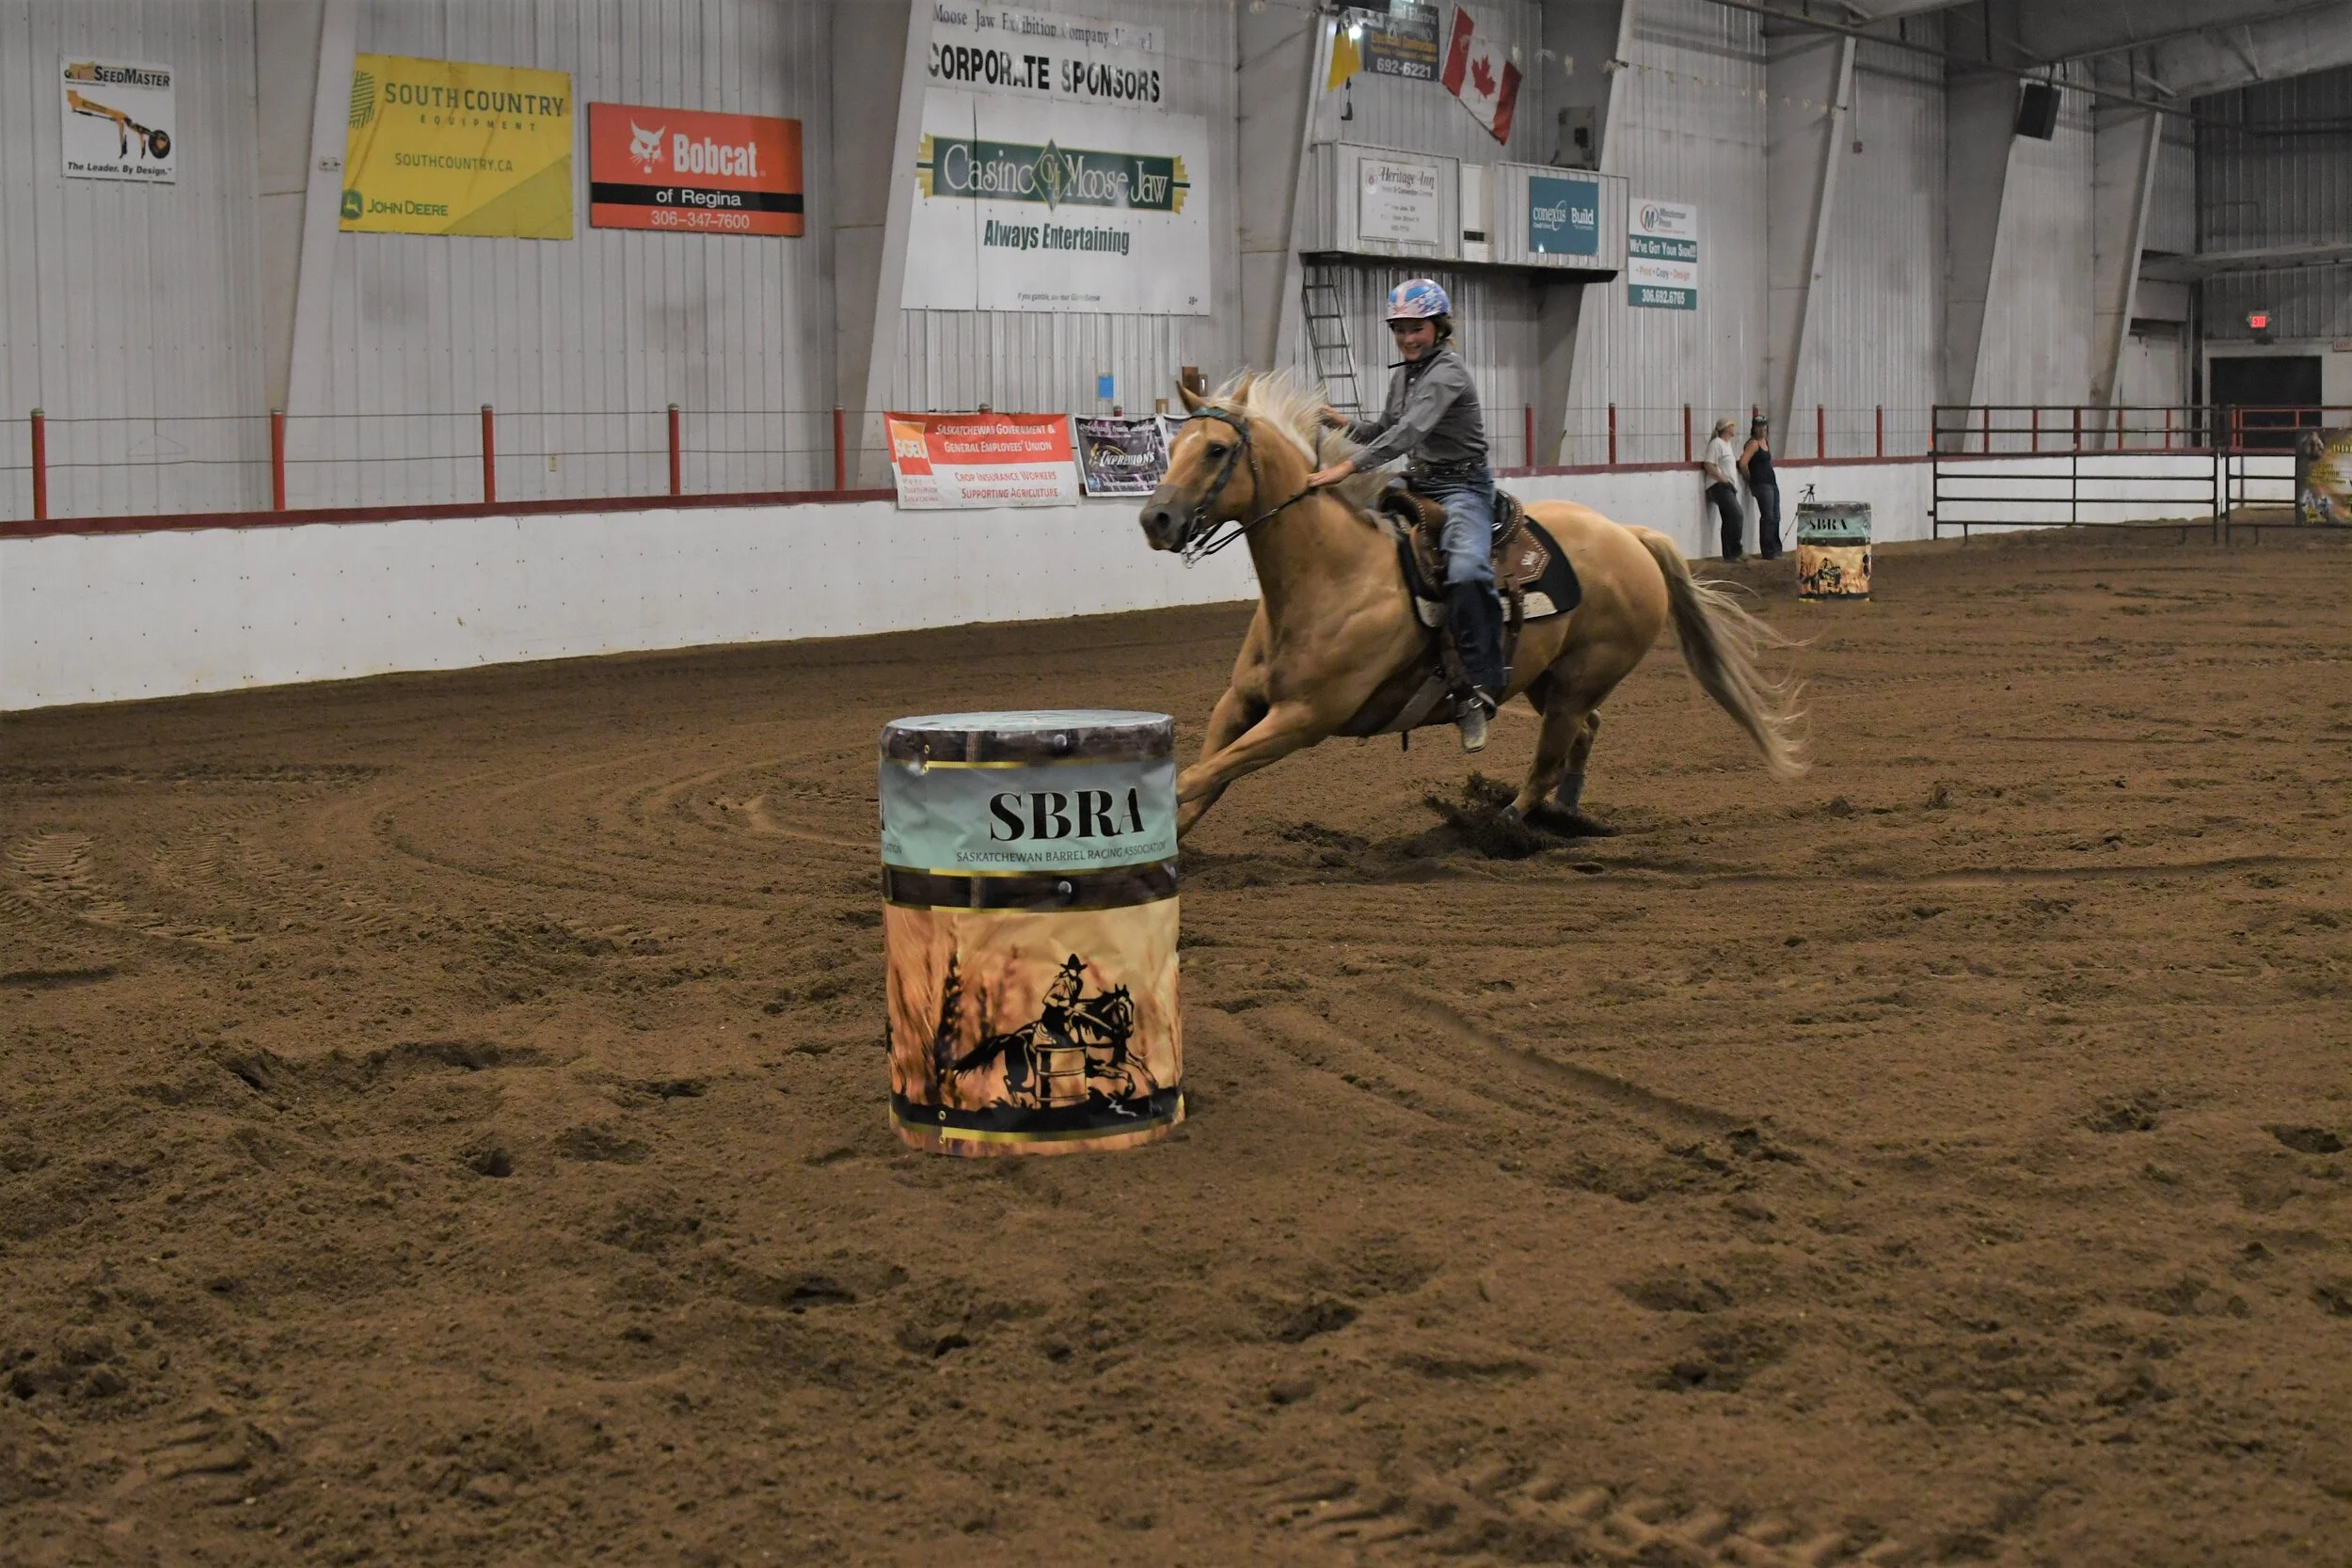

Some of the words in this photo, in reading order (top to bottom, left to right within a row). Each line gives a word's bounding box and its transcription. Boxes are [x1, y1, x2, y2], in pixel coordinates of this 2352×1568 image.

[975, 9, 994, 32] Jaw
[1002, 12, 1057, 37] Exibition
[1058, 24, 1109, 48] ompany
[1376, 57, 1431, 78] 692-6221
[1061, 58, 1160, 103] SPONSORS
[421, 114, 536, 132] EQUIPMENT
[395, 152, 513, 172] SOUTHCOUNTRY.CA
[673, 134, 757, 178] Bobcat
[68, 161, 84, 170] The
[87, 163, 119, 173] Leader.
[122, 165, 134, 174] By
[944, 144, 1034, 195] Casino
[1065, 153, 1129, 200] Moose
[1130, 160, 1168, 203] Jaw
[1378, 166, 1416, 188] Heritage
[1418, 171, 1435, 190] Inn
[367, 198, 403, 214] JOHN
[405, 200, 449, 216] DEERE
[657, 188, 674, 203] of
[682, 190, 741, 208] Regina
[651, 210, 750, 230] 306-347-7600
[1571, 207, 1594, 225] Build
[983, 220, 1039, 251] Always
[1042, 223, 1129, 256] Entertaining
[896, 439, 928, 459] SGEU
[1810, 518, 1848, 530] SBRA
[989, 787, 1145, 842] SBRA
[956, 851, 1042, 863] SASKATCHEWAN
[1045, 850, 1086, 862] BARREL
[1088, 847, 1122, 860] RACING
